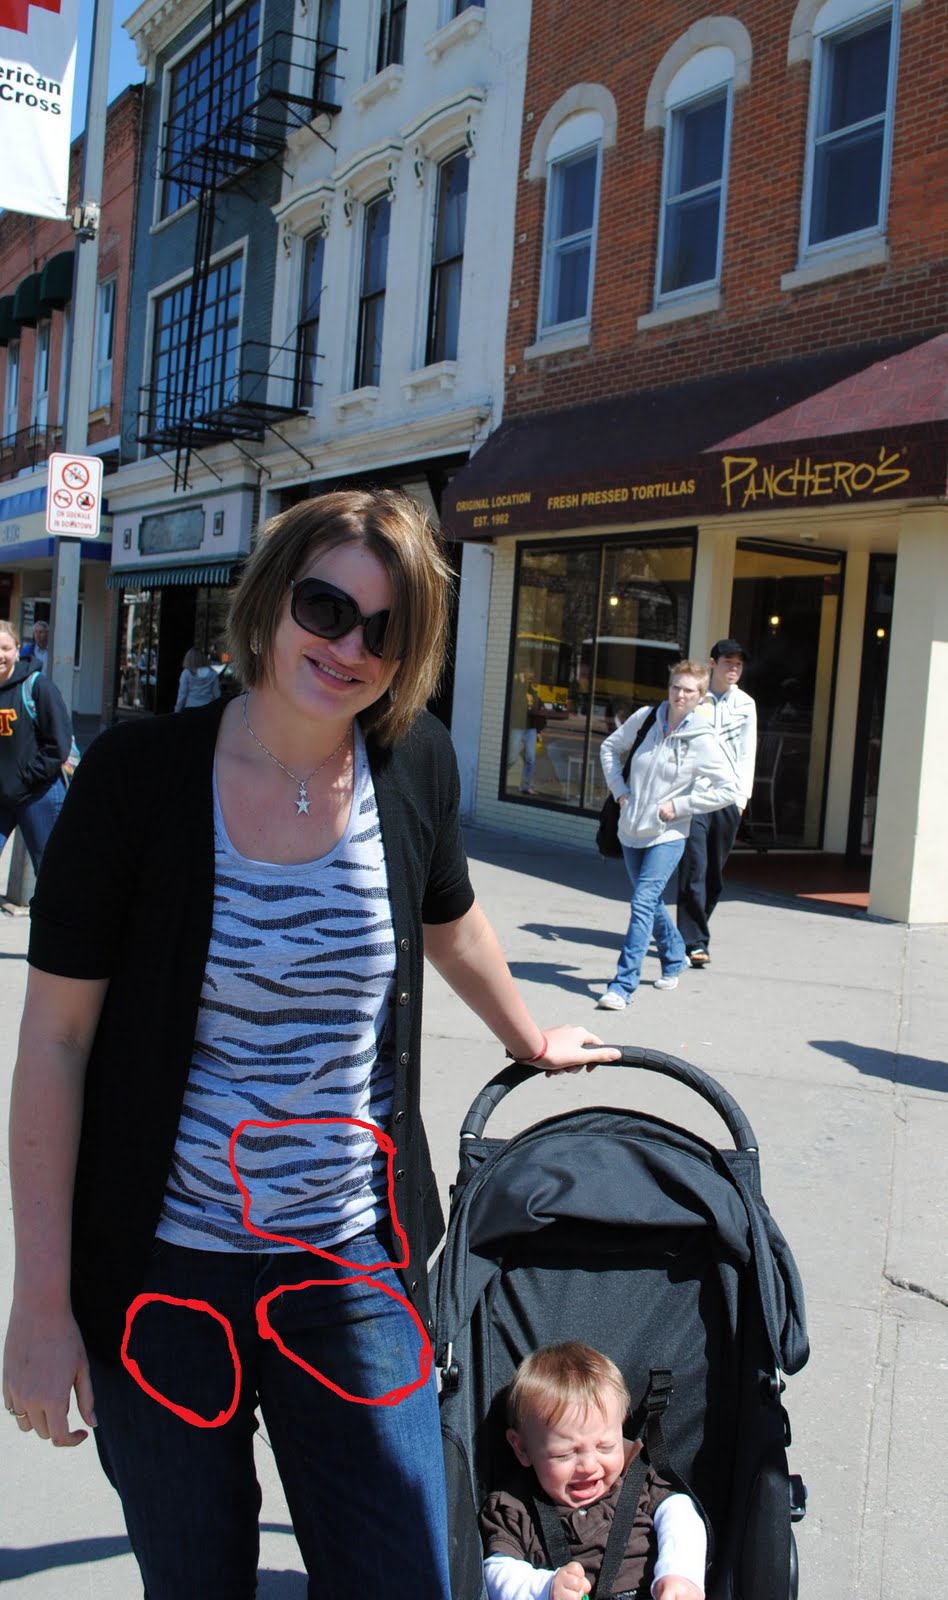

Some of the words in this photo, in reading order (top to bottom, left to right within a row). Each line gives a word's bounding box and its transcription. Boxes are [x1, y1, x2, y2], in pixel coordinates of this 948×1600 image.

[0, 83, 61, 115] Cross
[721, 446, 910, 508] PANCHERO'S
[456, 498, 490, 512] ORIGINAL
[491, 491, 531, 508] LOCATION
[547, 494, 579, 510] FRESH
[581, 488, 629, 506] PRESSED
[632, 479, 696, 500] TORTILLAS
[473, 515, 490, 528] EST.
